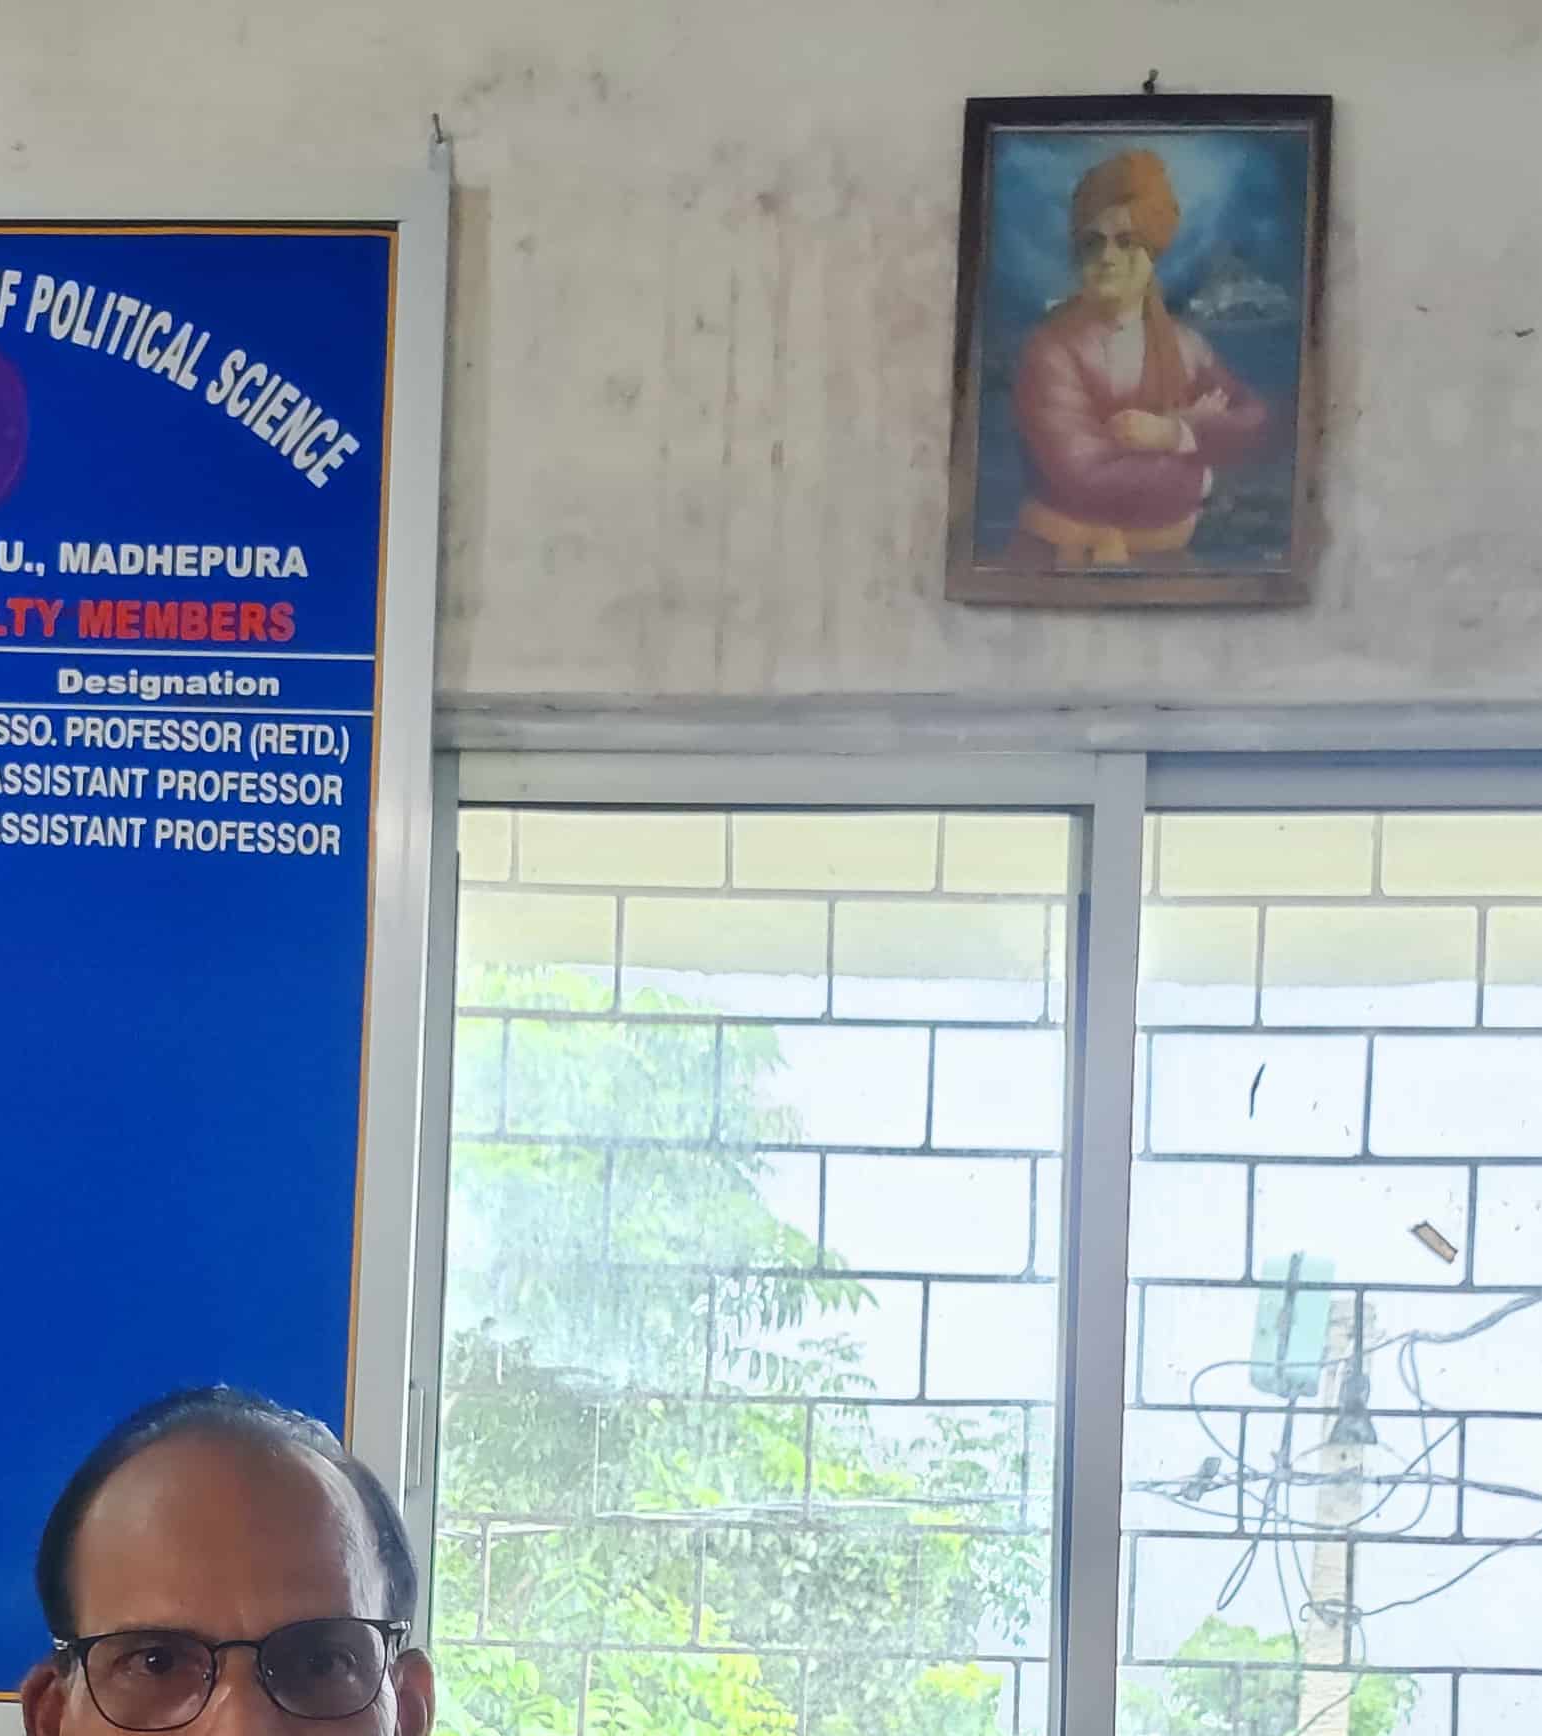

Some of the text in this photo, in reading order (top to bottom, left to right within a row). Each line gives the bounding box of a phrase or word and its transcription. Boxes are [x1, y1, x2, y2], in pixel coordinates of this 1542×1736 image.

[26, 278, 209, 386] POLITICAL
[207, 348, 360, 488] SCIENCE
[59, 542, 308, 577] MADHEPURA
[79, 600, 294, 641] MEMBERS
[59, 669, 279, 700] Designation
[66, 717, 241, 752] PROFESSOR
[251, 723, 349, 763] (RETD.)
[158, 769, 342, 805] PROFESSOR
[155, 819, 340, 855] PROFESSOR
